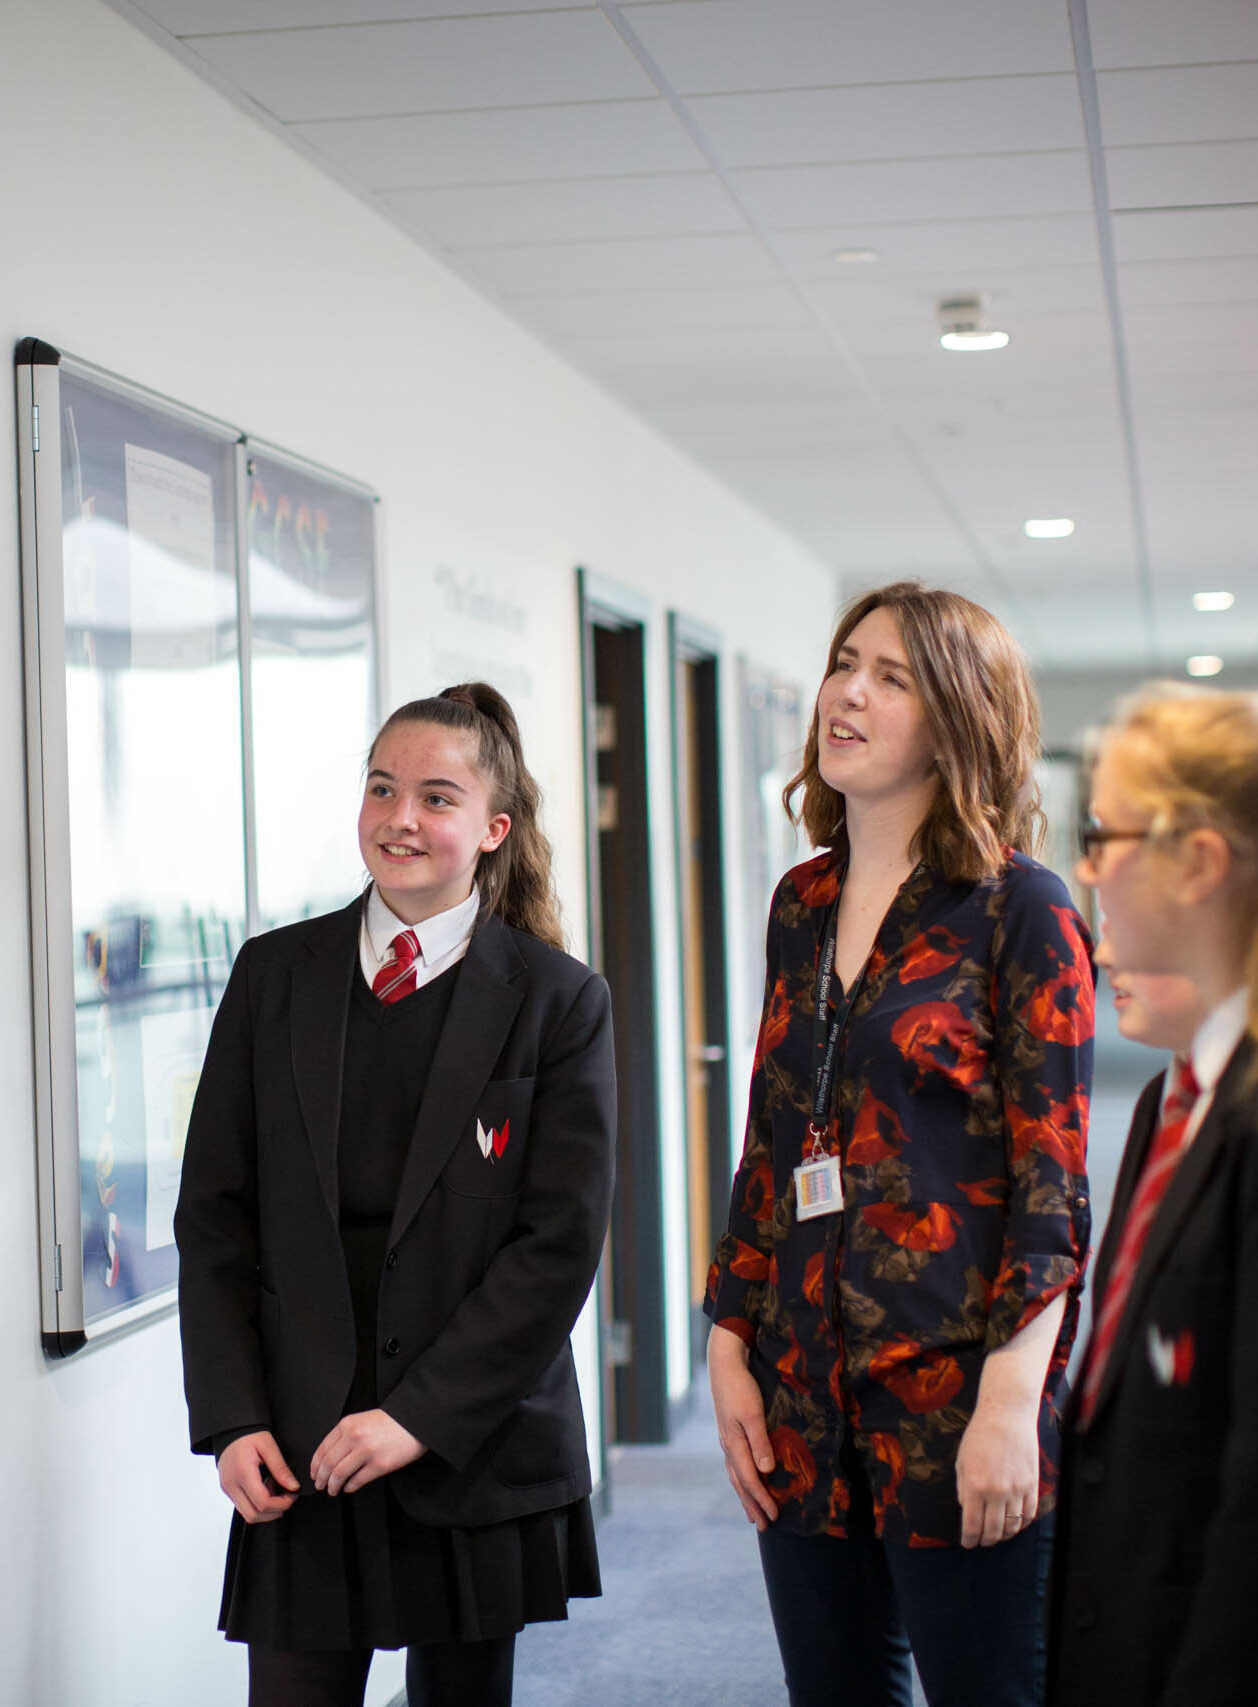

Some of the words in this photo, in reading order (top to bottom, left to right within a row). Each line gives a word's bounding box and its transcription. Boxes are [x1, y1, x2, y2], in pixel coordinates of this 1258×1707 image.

[820, 975, 831, 1001] School
[819, 1002, 827, 1021] Staff
[823, 1043, 834, 1072] School
[829, 1023, 839, 1043] Staff
